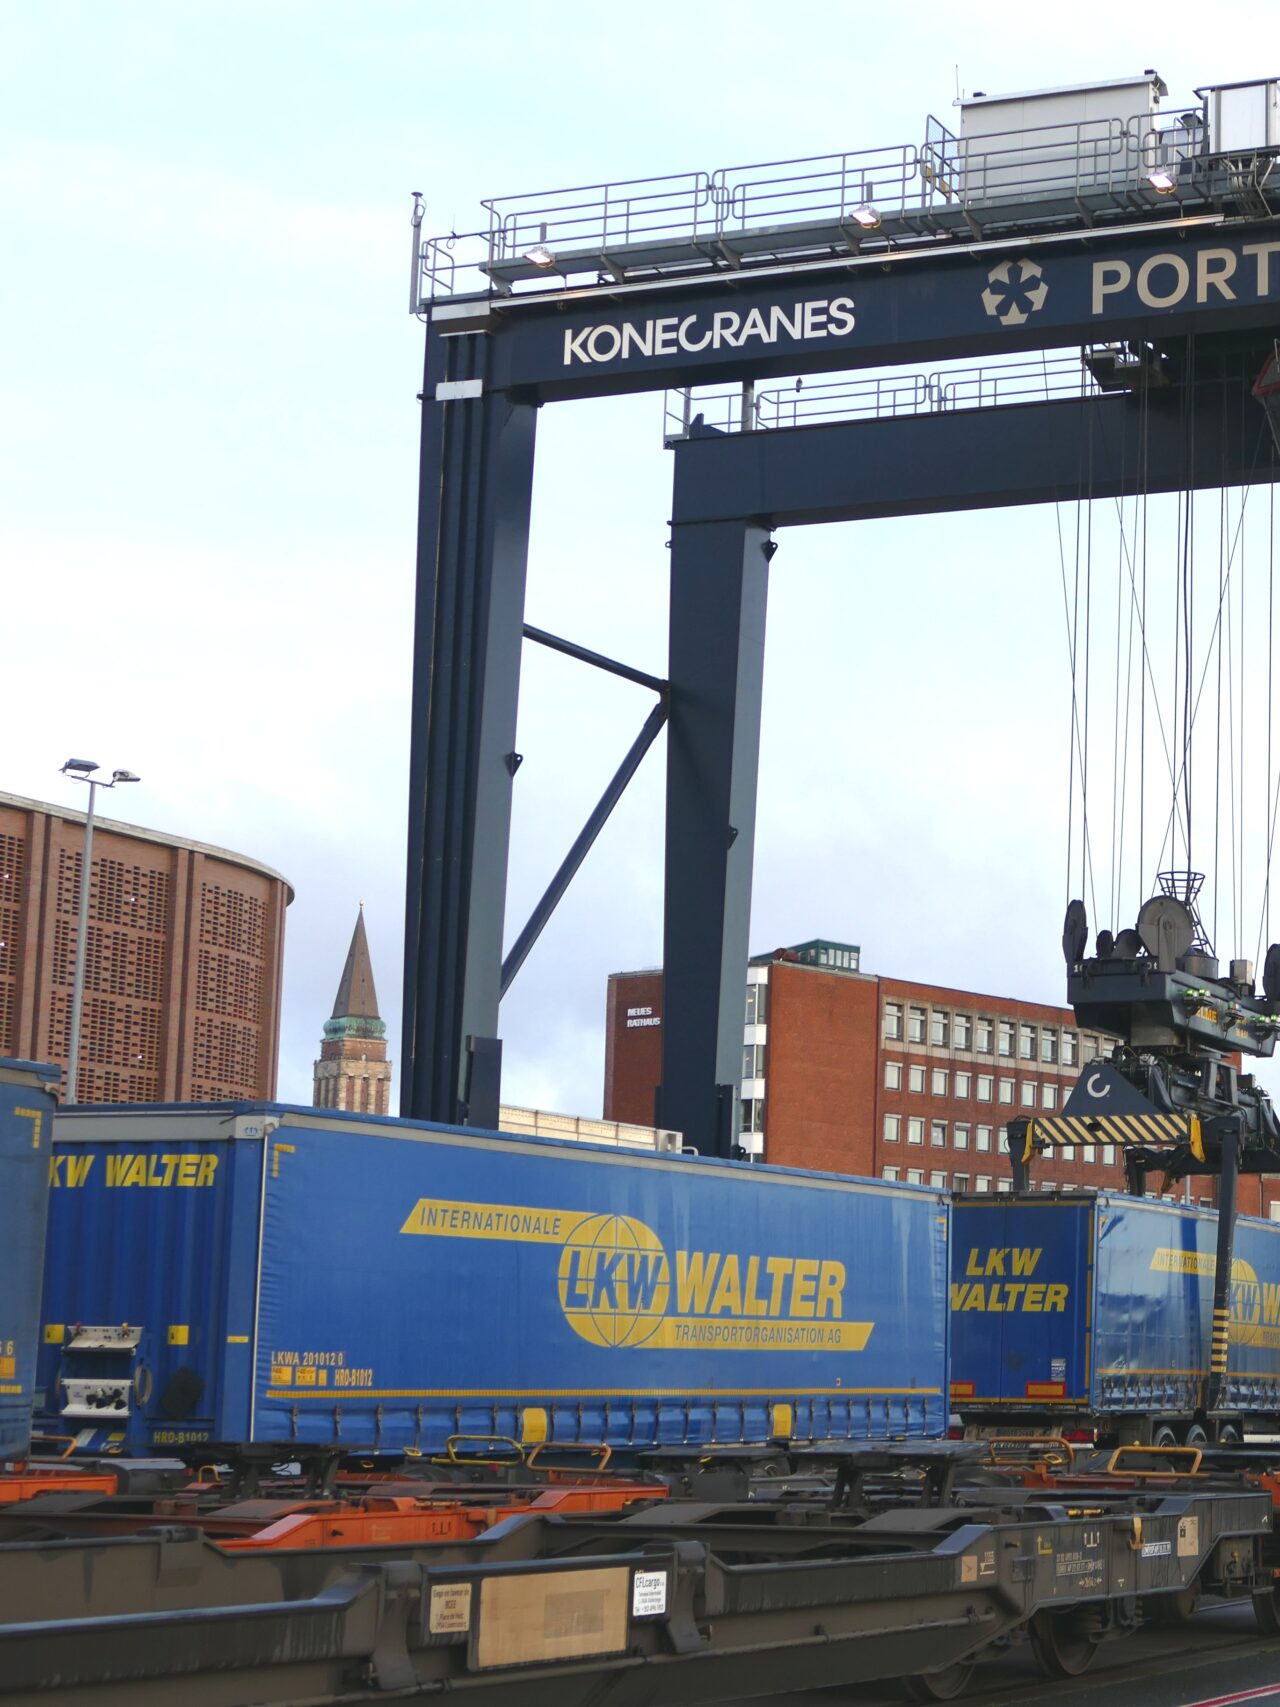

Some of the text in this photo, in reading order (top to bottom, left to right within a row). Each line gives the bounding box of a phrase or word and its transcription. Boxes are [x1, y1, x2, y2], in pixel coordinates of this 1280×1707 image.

[564, 297, 855, 365] KONECRANES
[627, 1007, 653, 1017] NEUES
[627, 1017, 661, 1028] RATHAUS
[49, 1154, 219, 1188] KW WALTER
[420, 1207, 562, 1236] INTERNATIONALE
[966, 1248, 1043, 1276] LKW
[565, 1249, 847, 1319] LKW WALTER
[675, 1324, 842, 1344] TRANSPORTORGANISATION AG
[271, 1351, 300, 1365] LKWA
[303, 1351, 336, 1366] 201012
